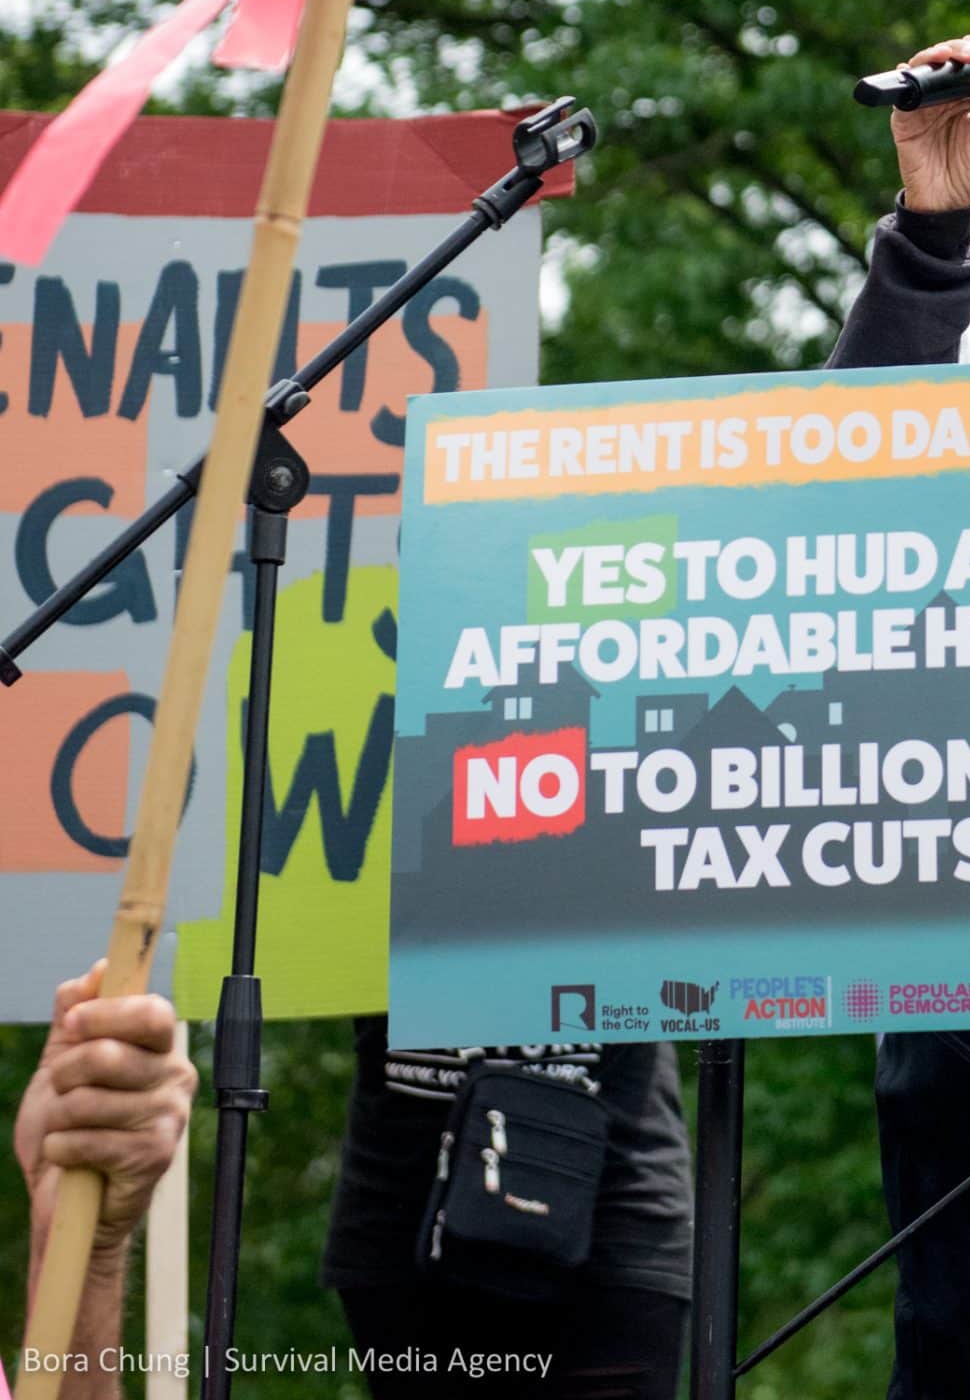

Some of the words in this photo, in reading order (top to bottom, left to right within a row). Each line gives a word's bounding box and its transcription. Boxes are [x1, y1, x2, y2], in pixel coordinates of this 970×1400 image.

[0, 260, 482, 448] NANTS
[436, 429, 540, 482] THE
[549, 421, 692, 477] RENT
[700, 417, 748, 469] IS
[756, 412, 881, 467] TOO
[531, 542, 666, 607] YES
[673, 537, 777, 601] TO
[786, 531, 938, 597] HUD
[443, 608, 916, 688] AFFORDABLE
[466, 754, 580, 819] NO
[590, 749, 697, 814] TO
[641, 824, 792, 891] TAX
[602, 1005, 636, 1018] Right
[639, 1006, 649, 1016] to
[730, 976, 825, 1000] PEOPLE'S
[744, 997, 826, 1020] ACTION
[602, 1020, 623, 1031] the
[625, 1018, 649, 1032] City
[660, 1018, 720, 1033] VOCAL-US
